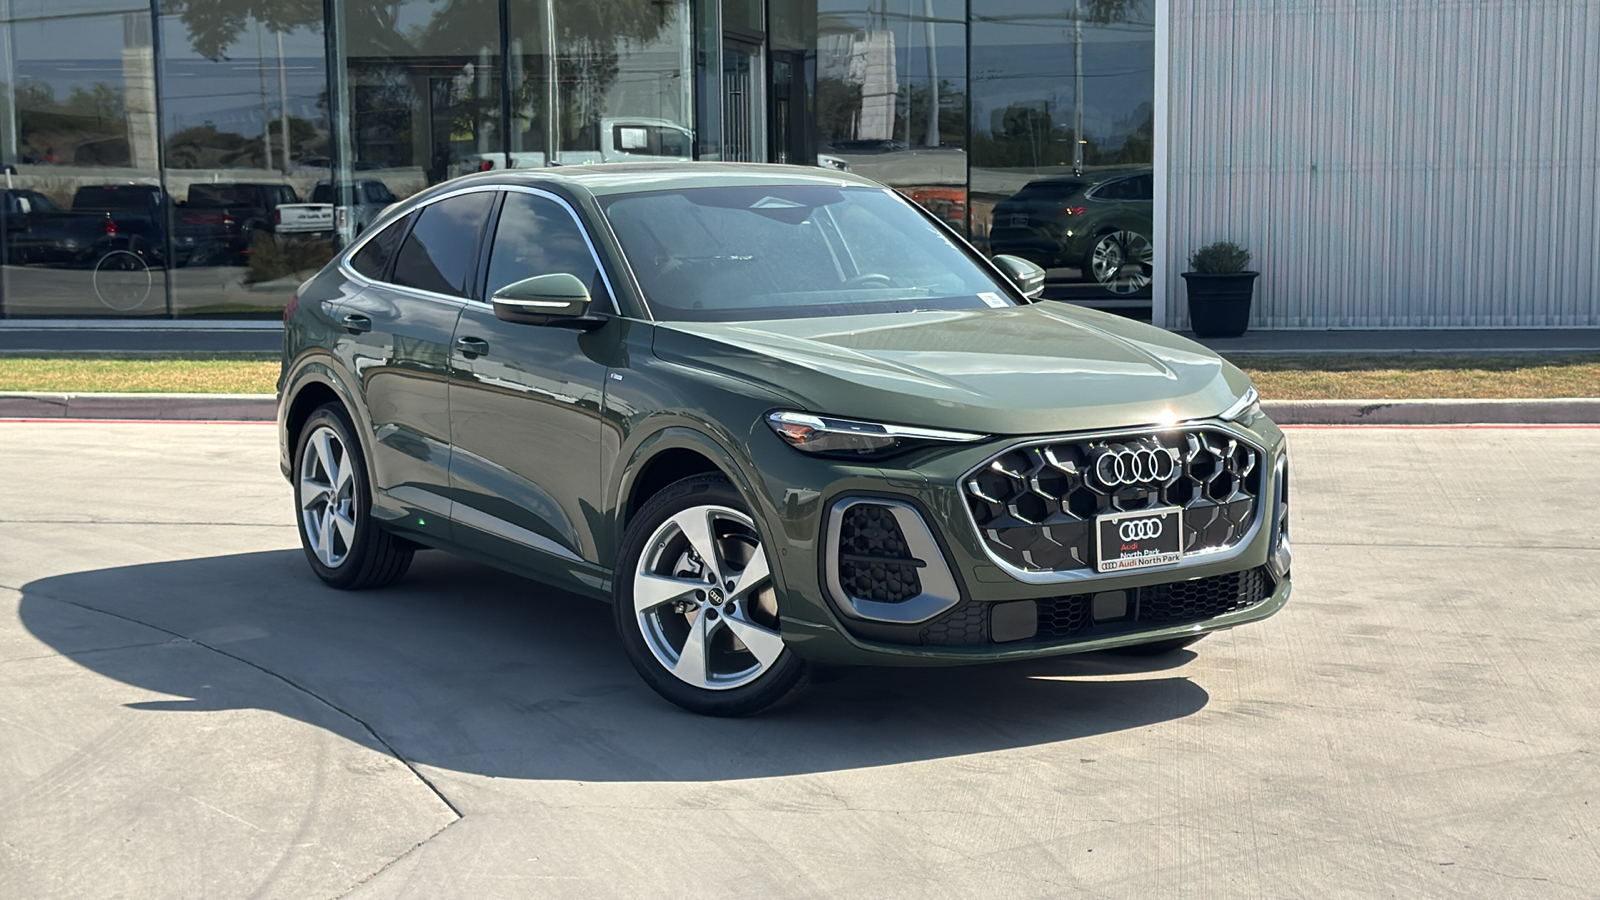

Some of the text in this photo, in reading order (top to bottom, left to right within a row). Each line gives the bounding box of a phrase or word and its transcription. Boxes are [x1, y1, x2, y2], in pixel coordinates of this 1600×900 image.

[1121, 542, 1138, 551] Audi
[1120, 548, 1160, 560] North Park
[1118, 554, 1180, 568] Audi North Park
